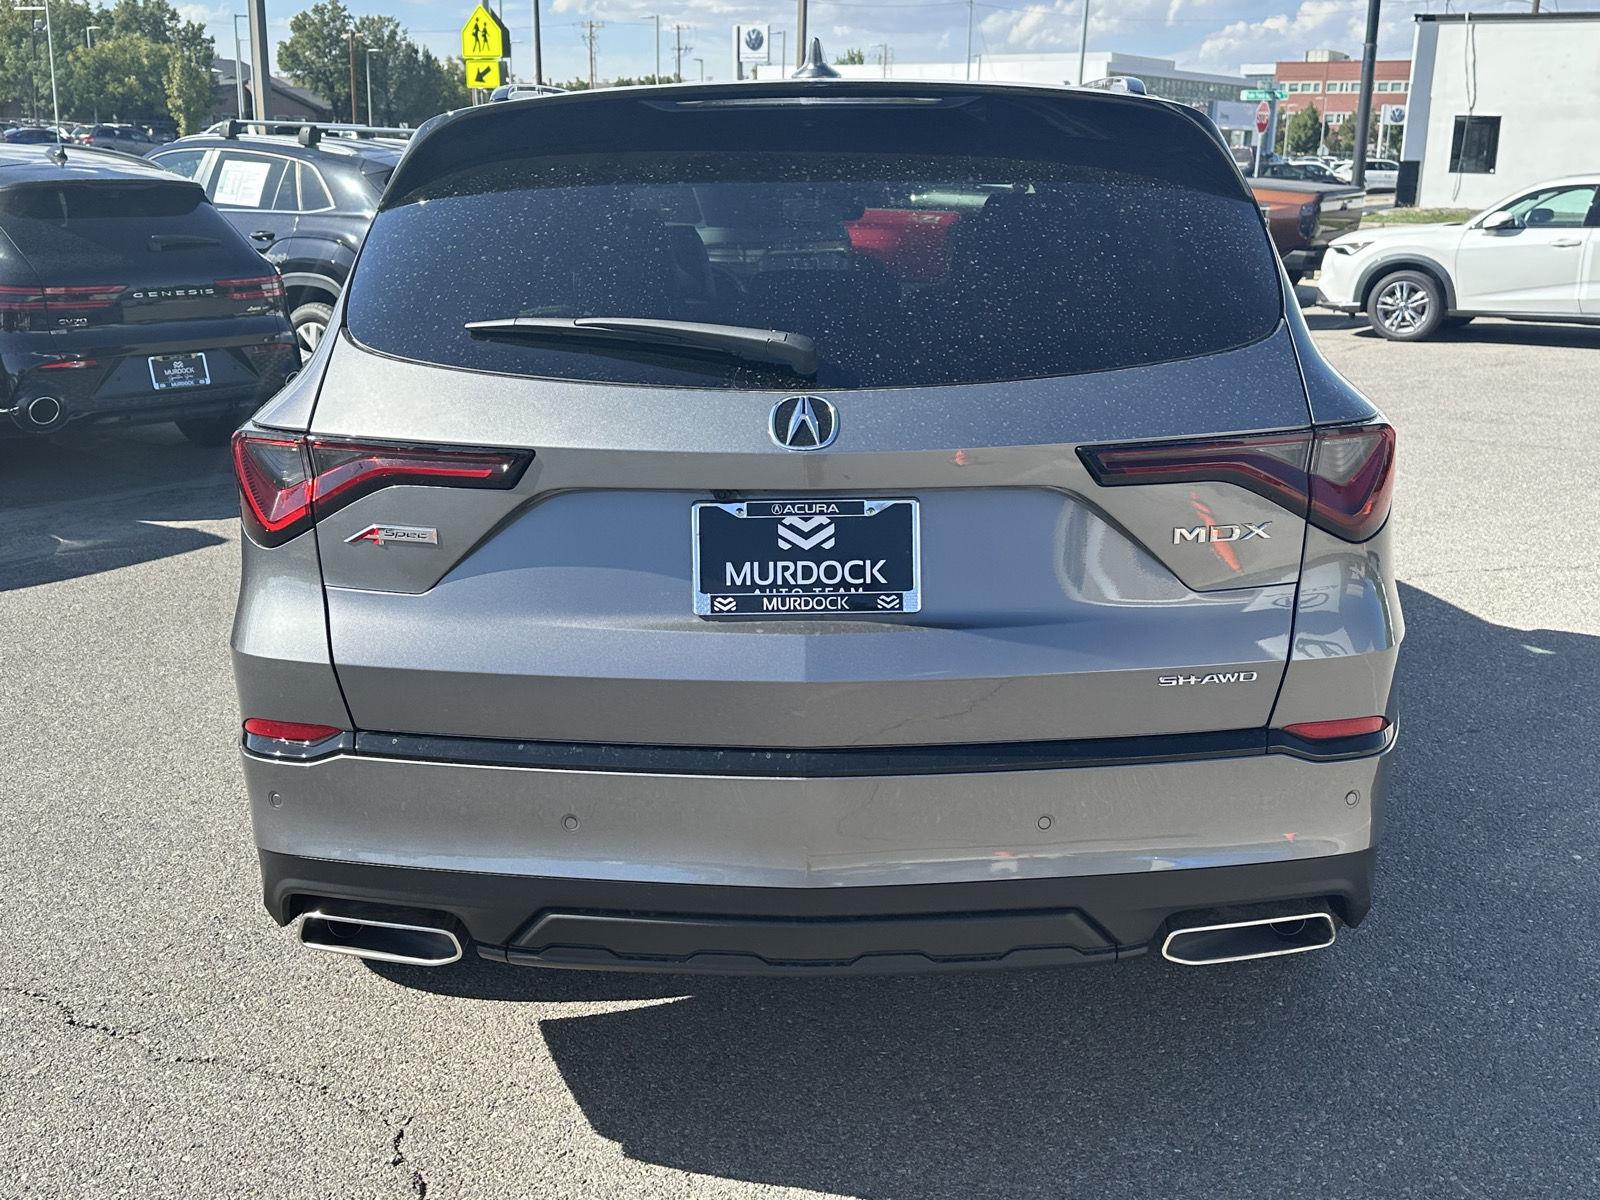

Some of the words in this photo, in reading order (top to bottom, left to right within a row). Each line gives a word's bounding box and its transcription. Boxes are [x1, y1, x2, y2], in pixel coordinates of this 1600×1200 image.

[132, 288, 215, 299] GENESIS
[164, 367, 195, 376] MURDOCK
[783, 503, 840, 514] ACURA
[1172, 520, 1273, 545] MDX
[725, 559, 888, 587] MURDOCK
[762, 596, 850, 611] MURDOCK
[1158, 671, 1258, 687] SH-AWD
